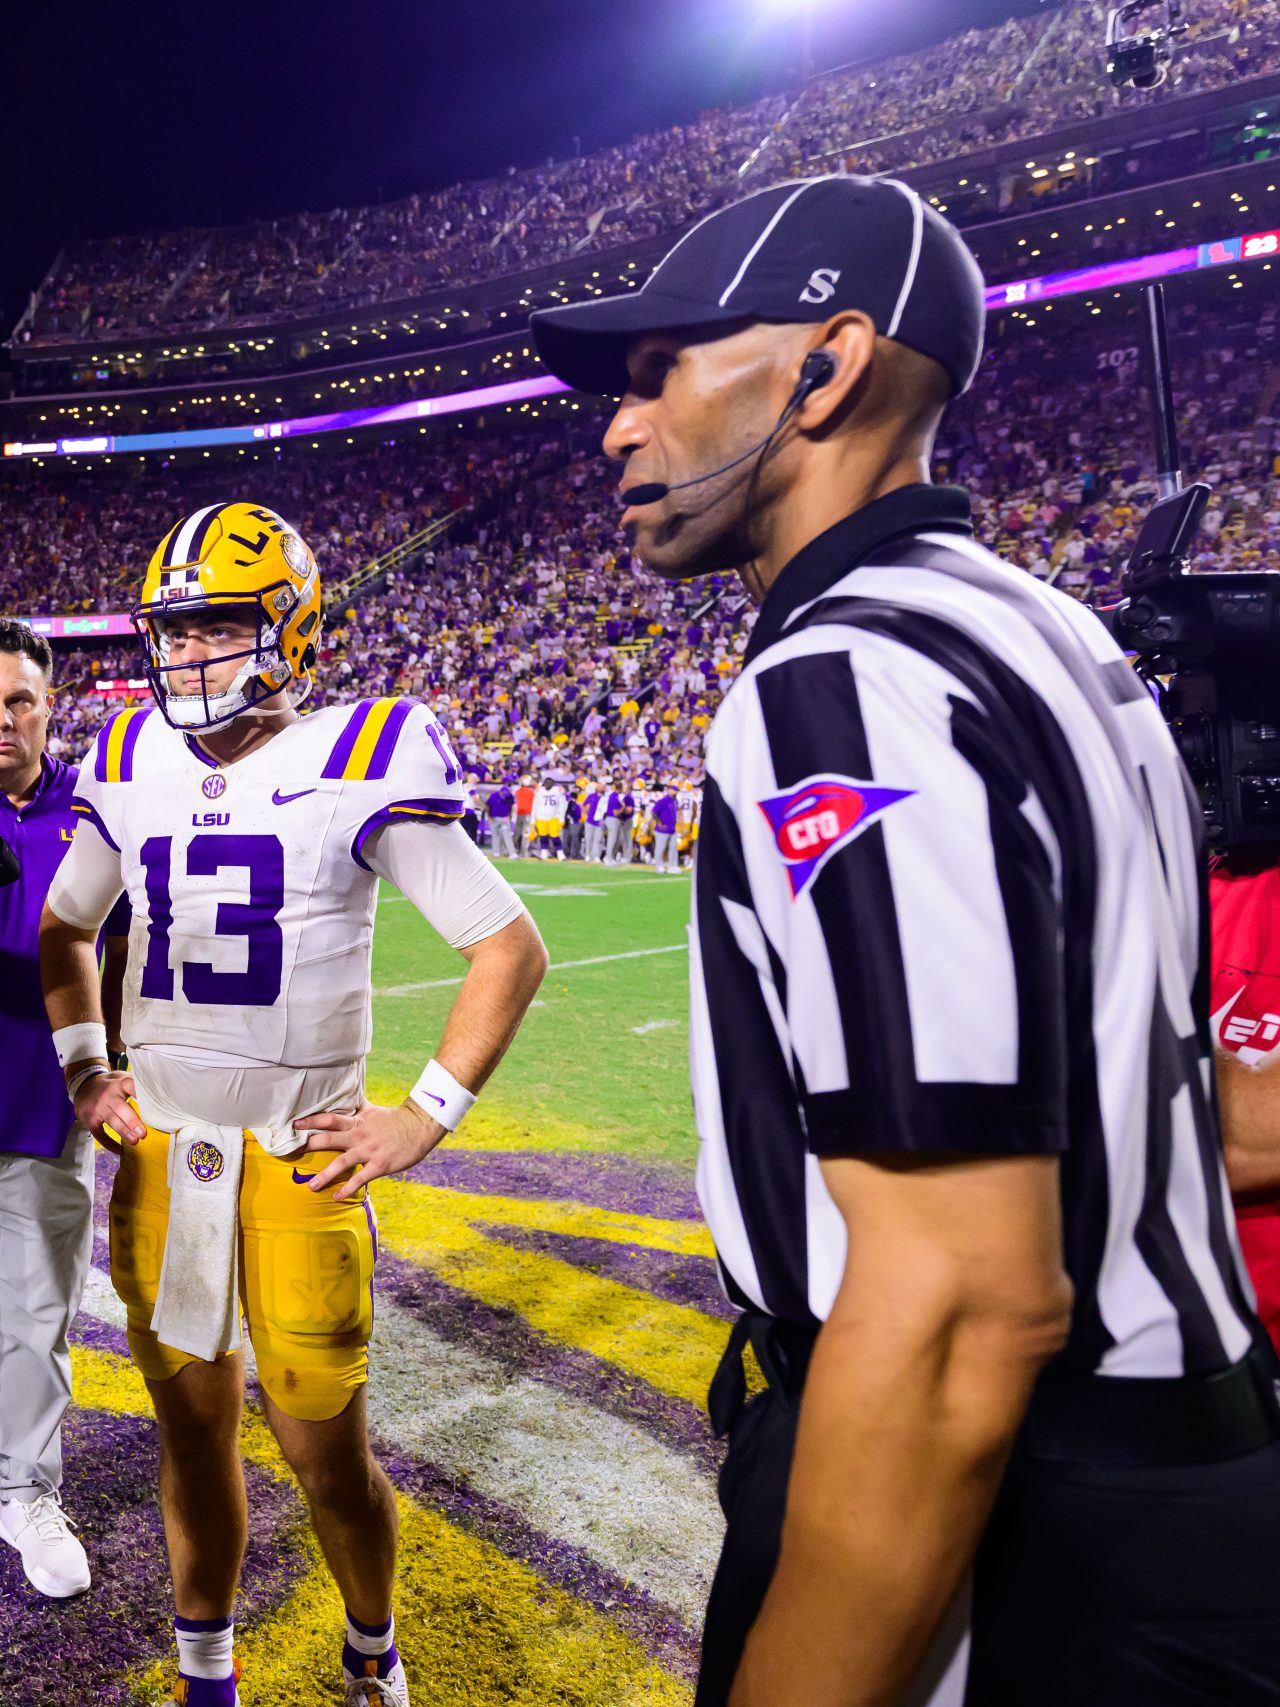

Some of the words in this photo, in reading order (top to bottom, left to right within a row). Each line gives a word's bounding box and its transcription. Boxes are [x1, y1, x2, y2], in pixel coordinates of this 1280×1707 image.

[799, 268, 841, 303] S
[228, 510, 284, 556] LS
[161, 586, 189, 602] LSU
[203, 775, 225, 798] SEC
[192, 813, 230, 827] LSU
[786, 810, 840, 850] CFO
[140, 834, 284, 1006] 13
